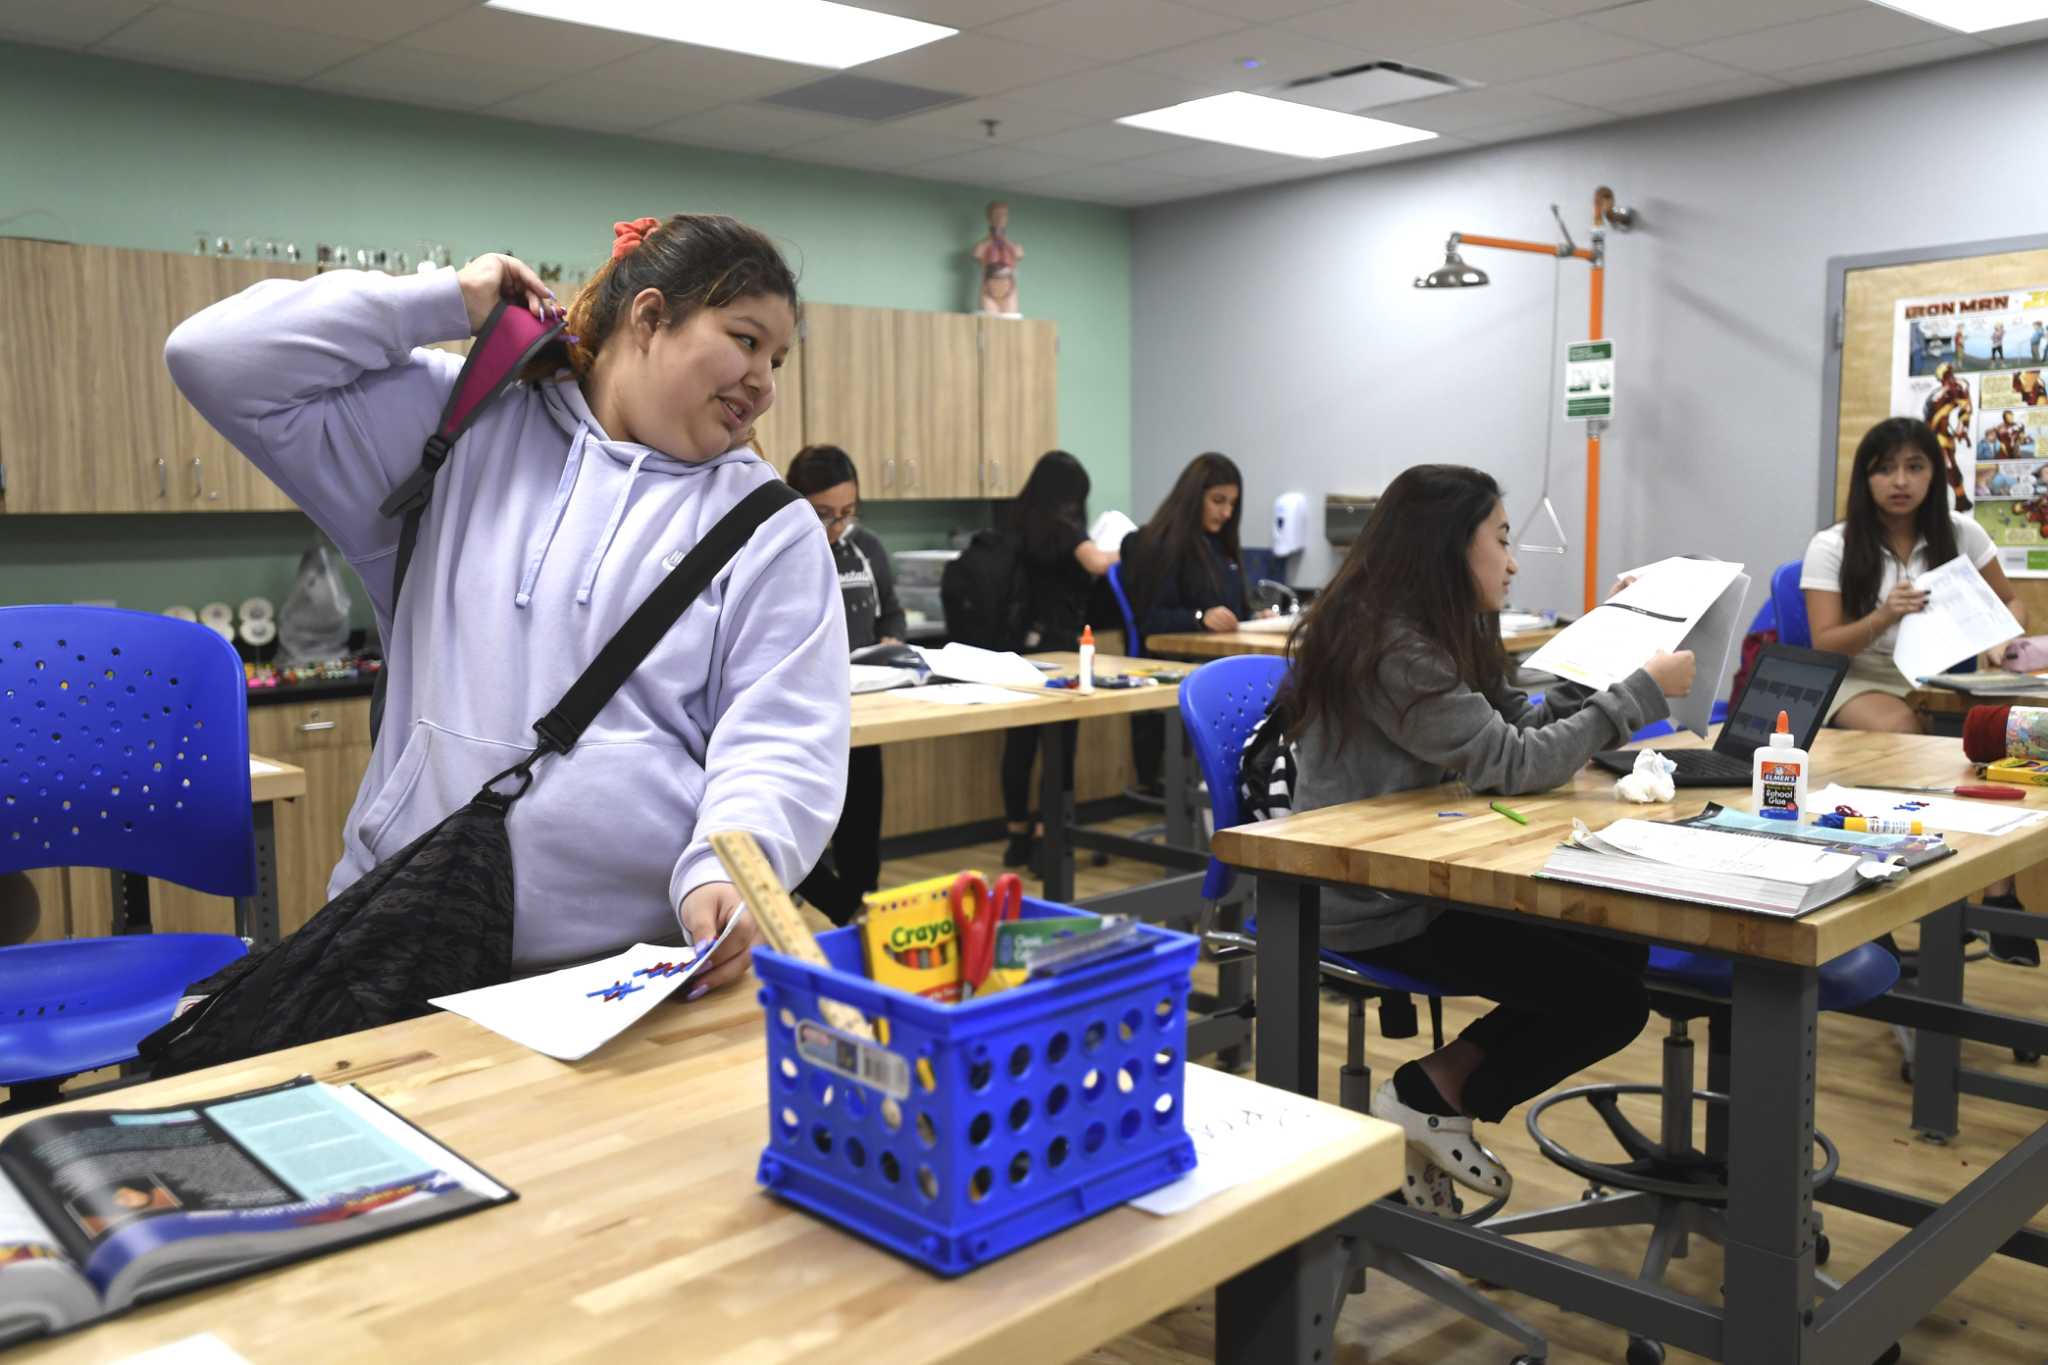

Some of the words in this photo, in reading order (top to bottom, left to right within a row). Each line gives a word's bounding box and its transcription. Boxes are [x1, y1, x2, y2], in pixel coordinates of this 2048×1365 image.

[1905, 301, 1955, 319] IRON
[1960, 295, 2009, 312] MAN
[1766, 789, 1793, 798] School
[890, 919, 955, 948] Crayo
